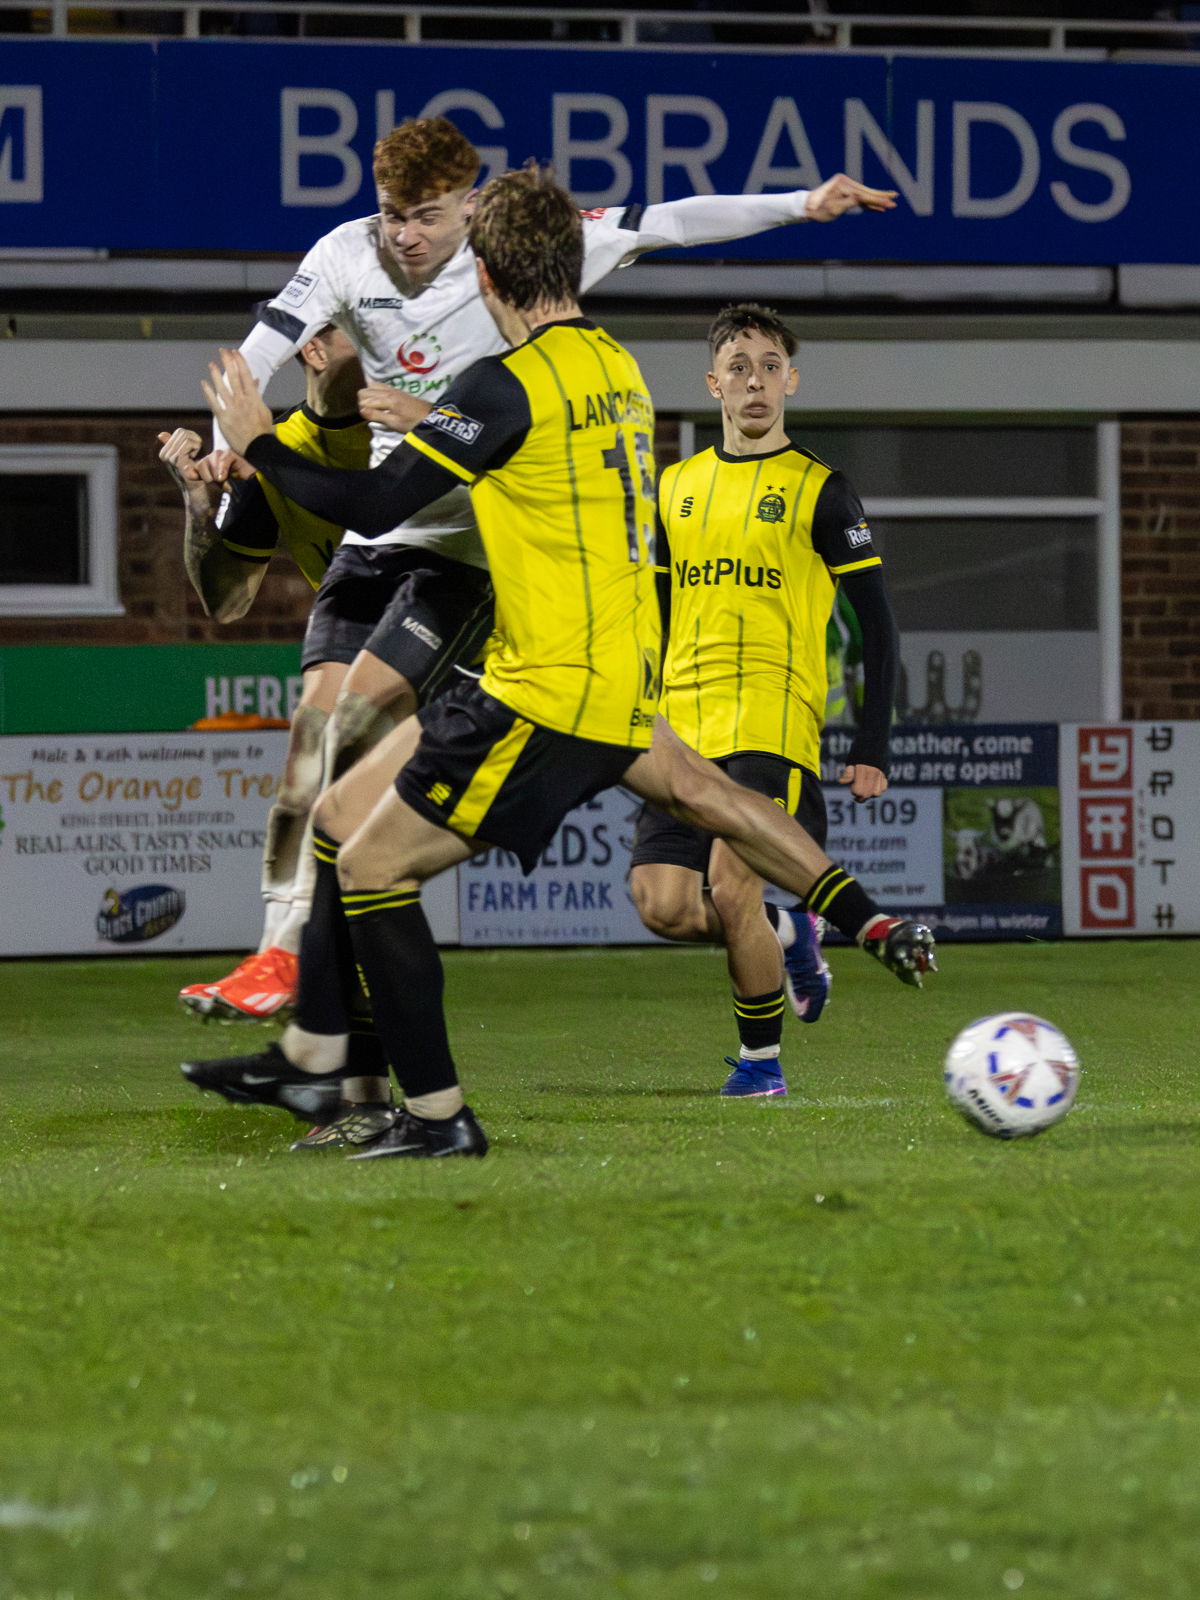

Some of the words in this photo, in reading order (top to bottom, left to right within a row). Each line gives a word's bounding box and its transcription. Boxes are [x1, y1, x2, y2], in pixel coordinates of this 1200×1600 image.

[553, 94, 1131, 222] BRANDS
[567, 390, 640, 431] LANC
[138, 747, 205, 762] welcome
[212, 748, 240, 765] you
[247, 746, 264, 759] to
[889, 732, 970, 758] eather,
[973, 736, 1034, 754] come
[919, 764, 956, 781] are
[959, 758, 1024, 784] open!
[1, 769, 63, 803] The
[78, 770, 202, 811] Orange
[217, 767, 281, 799] Tre
[15, 834, 66, 855] REAL
[131, 830, 193, 851] TASTY
[197, 828, 266, 850] SNACK
[84, 855, 144, 876] GOOD
[149, 852, 212, 874] TIMES
[468, 881, 538, 912] FARM
[548, 881, 613, 911] PARK
